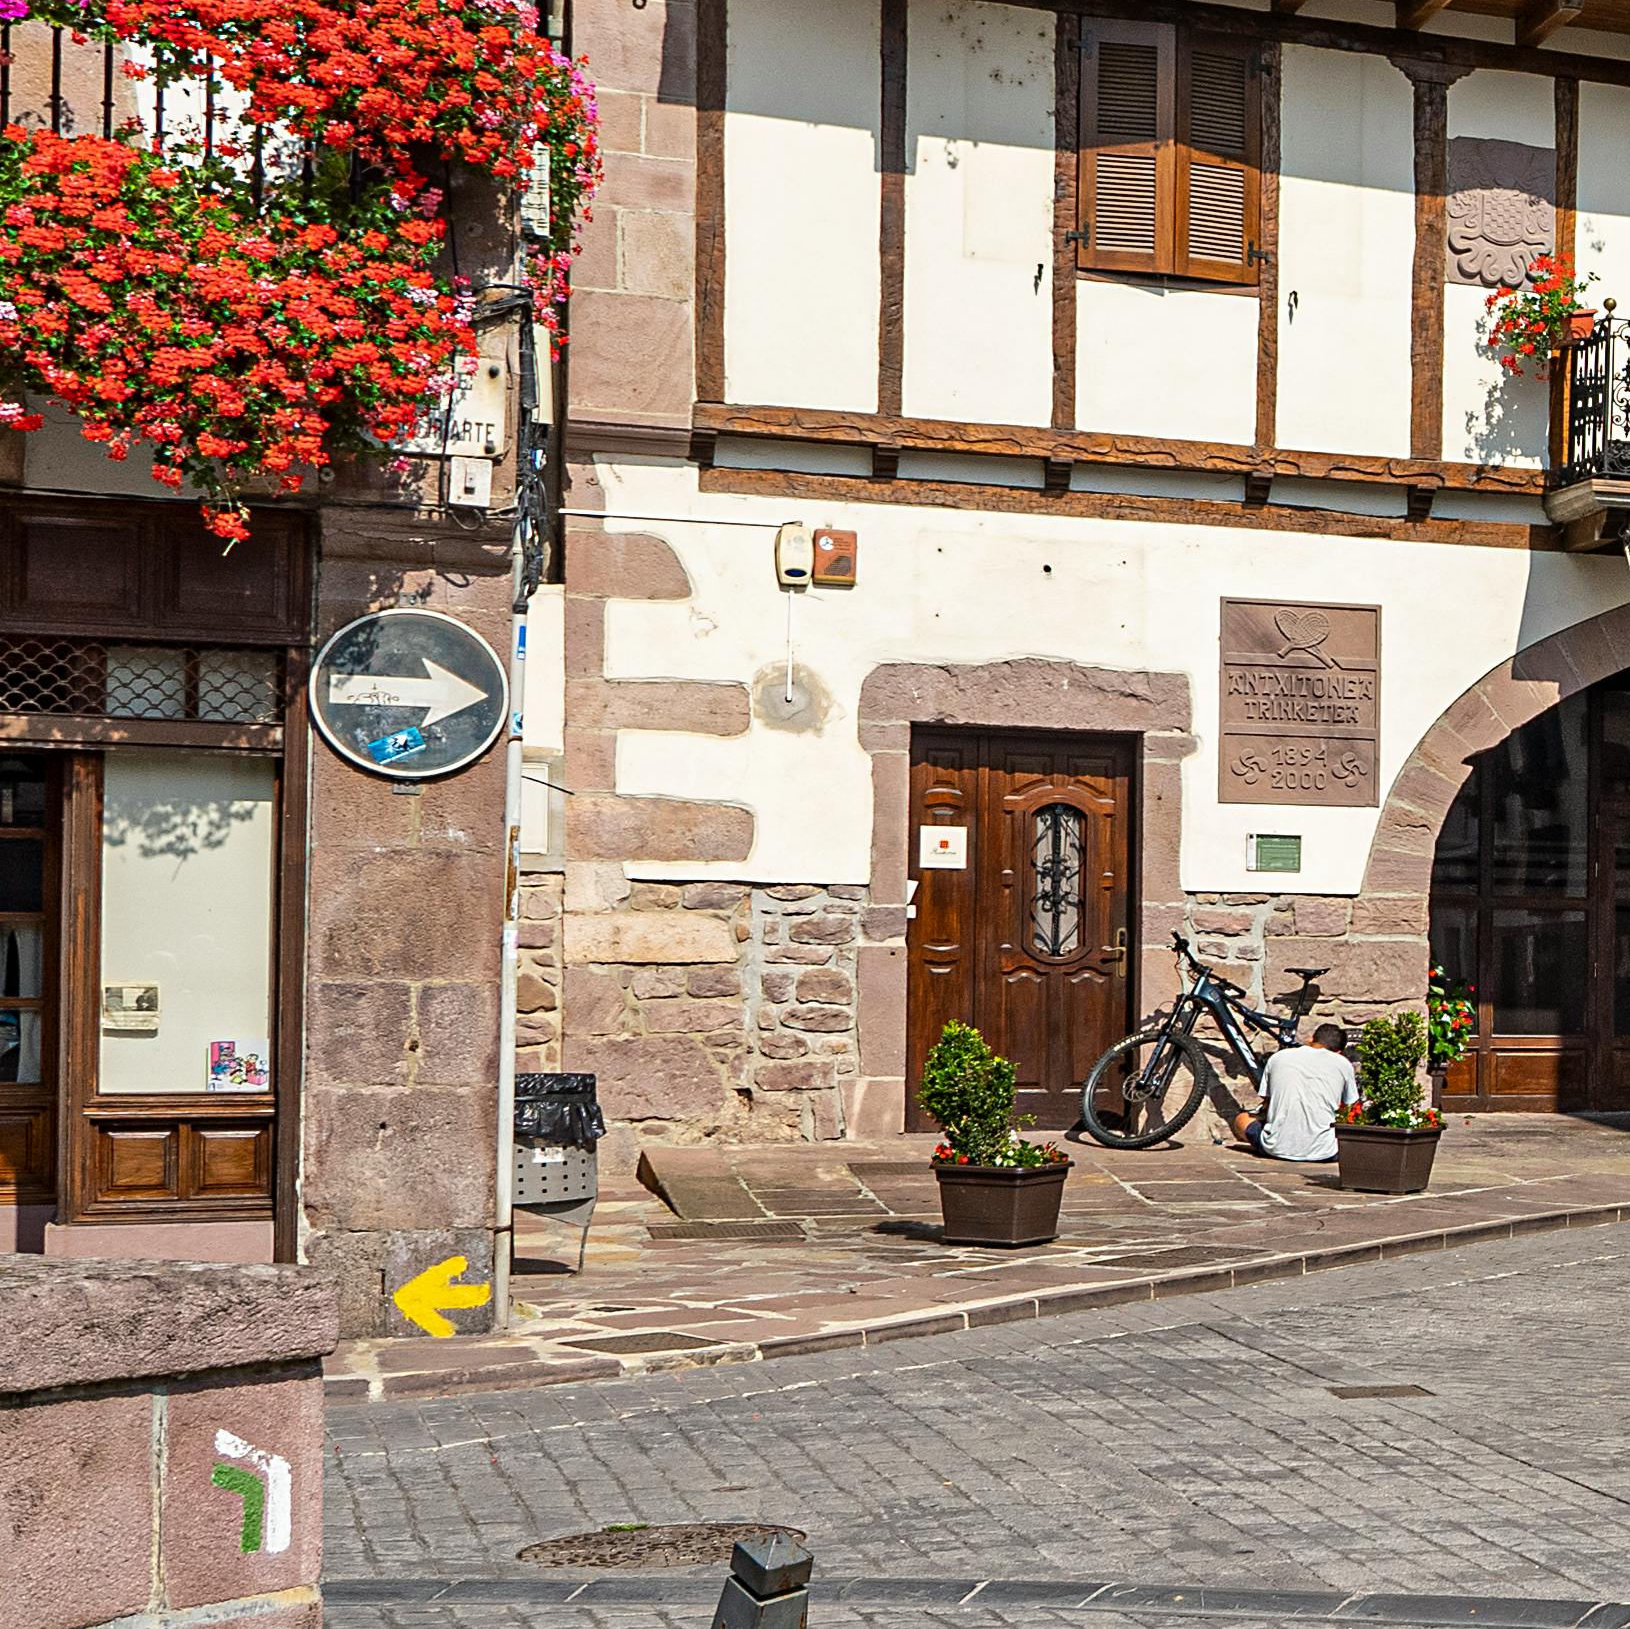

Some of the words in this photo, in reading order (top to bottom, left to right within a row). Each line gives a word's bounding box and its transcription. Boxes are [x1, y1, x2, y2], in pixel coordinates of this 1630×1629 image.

[1228, 671, 1373, 701] ANTXITONEA
[1244, 699, 1359, 724] TRINKETEA
[1271, 745, 1328, 768] 1894
[1271, 769, 1327, 791] 2000
